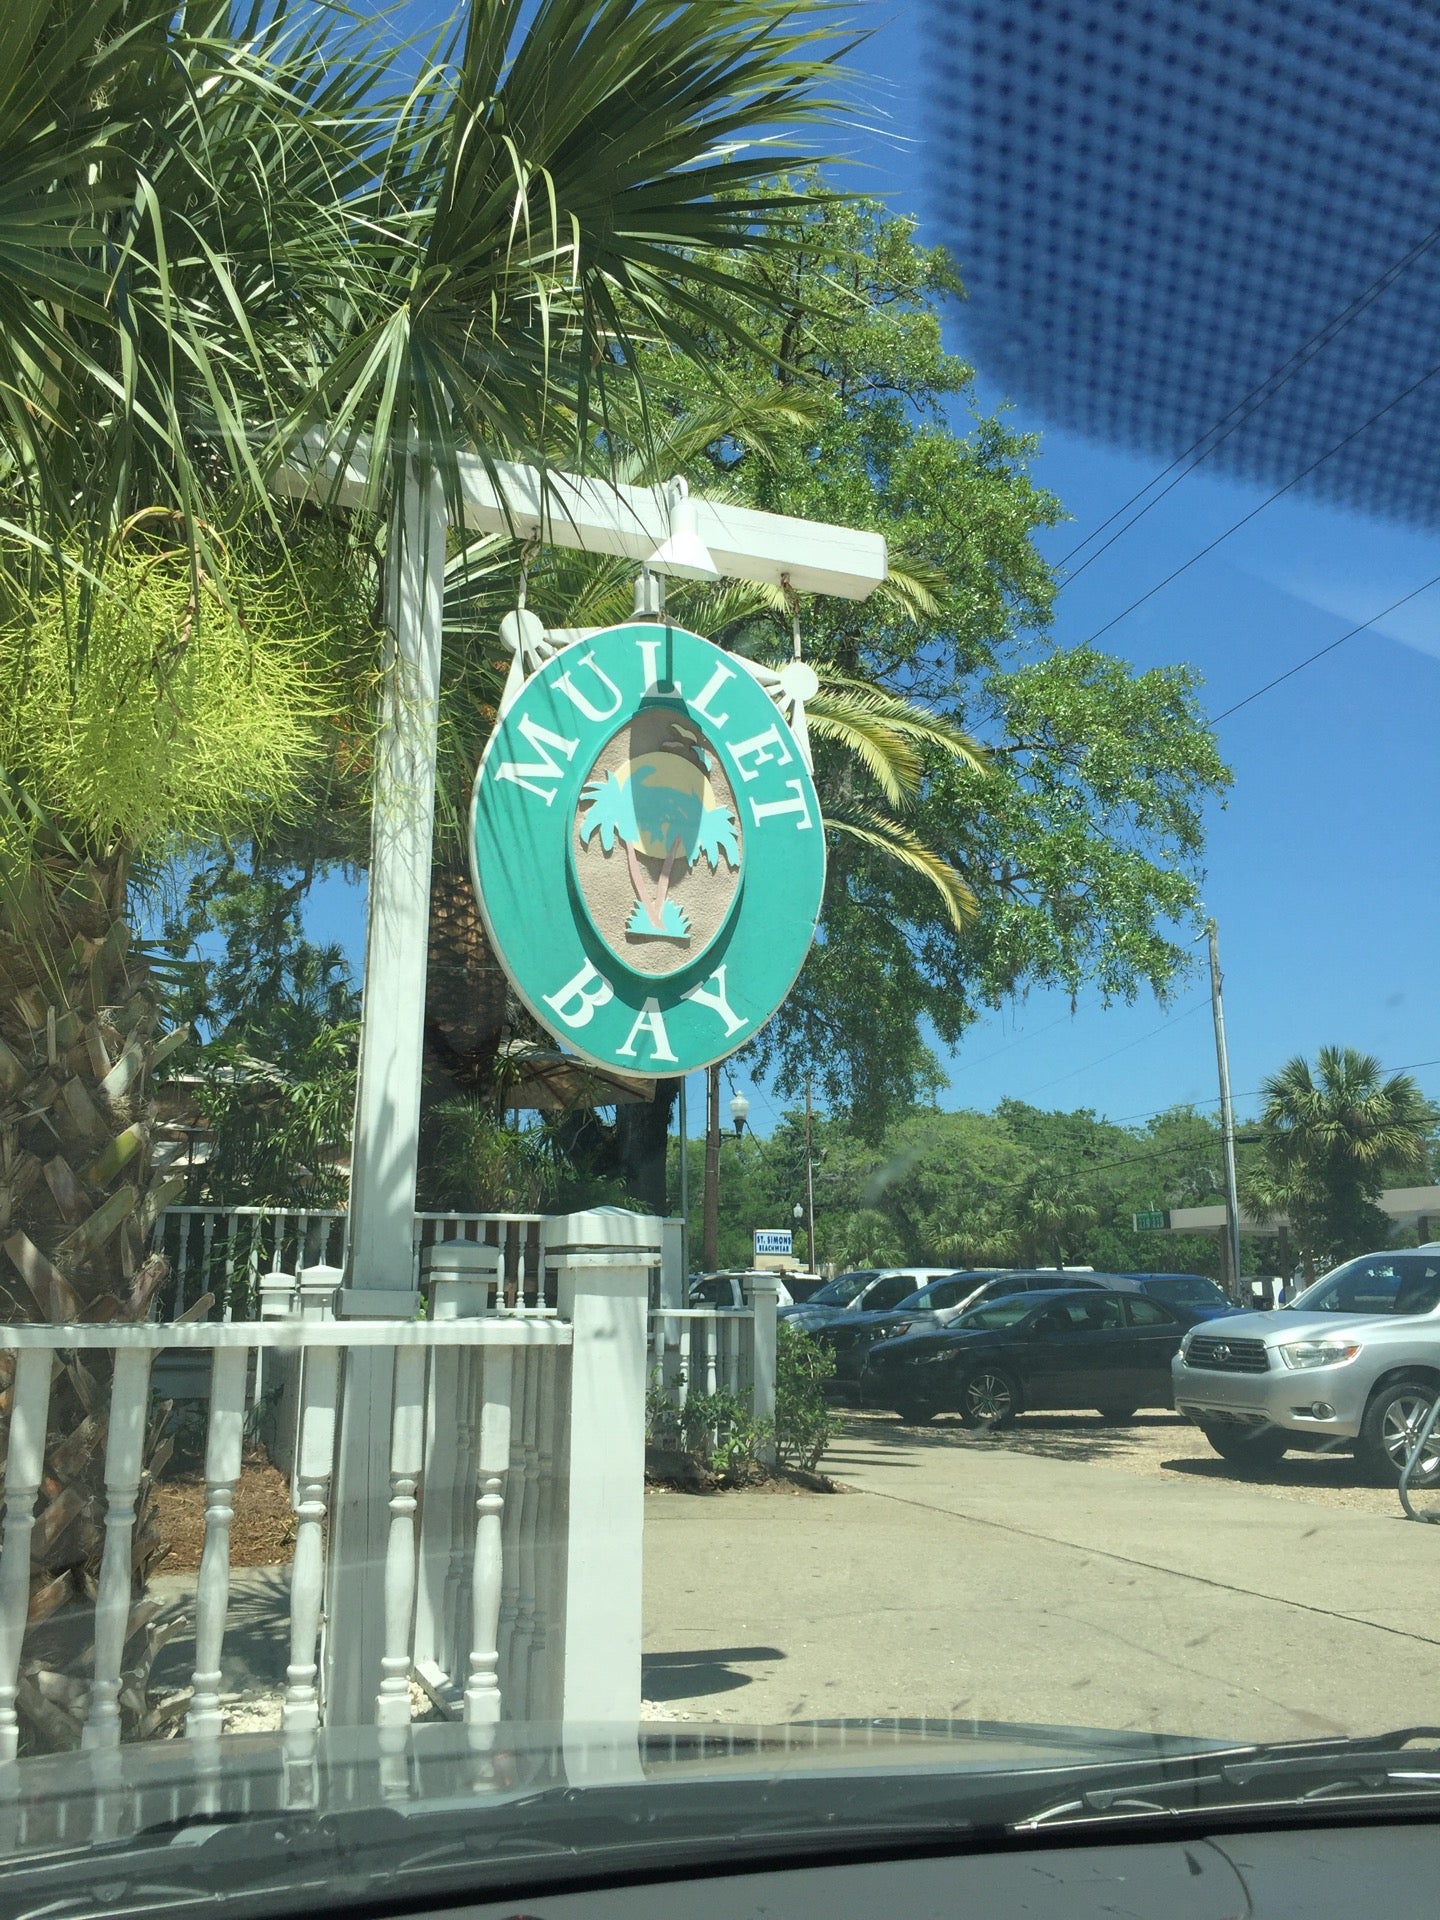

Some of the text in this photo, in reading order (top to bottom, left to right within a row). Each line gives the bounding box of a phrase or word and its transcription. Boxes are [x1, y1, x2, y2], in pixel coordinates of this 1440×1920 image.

[494, 641, 813, 829] MULLET
[542, 958, 749, 1062] BAY
[757, 1235, 791, 1245] ST. SIMONS
